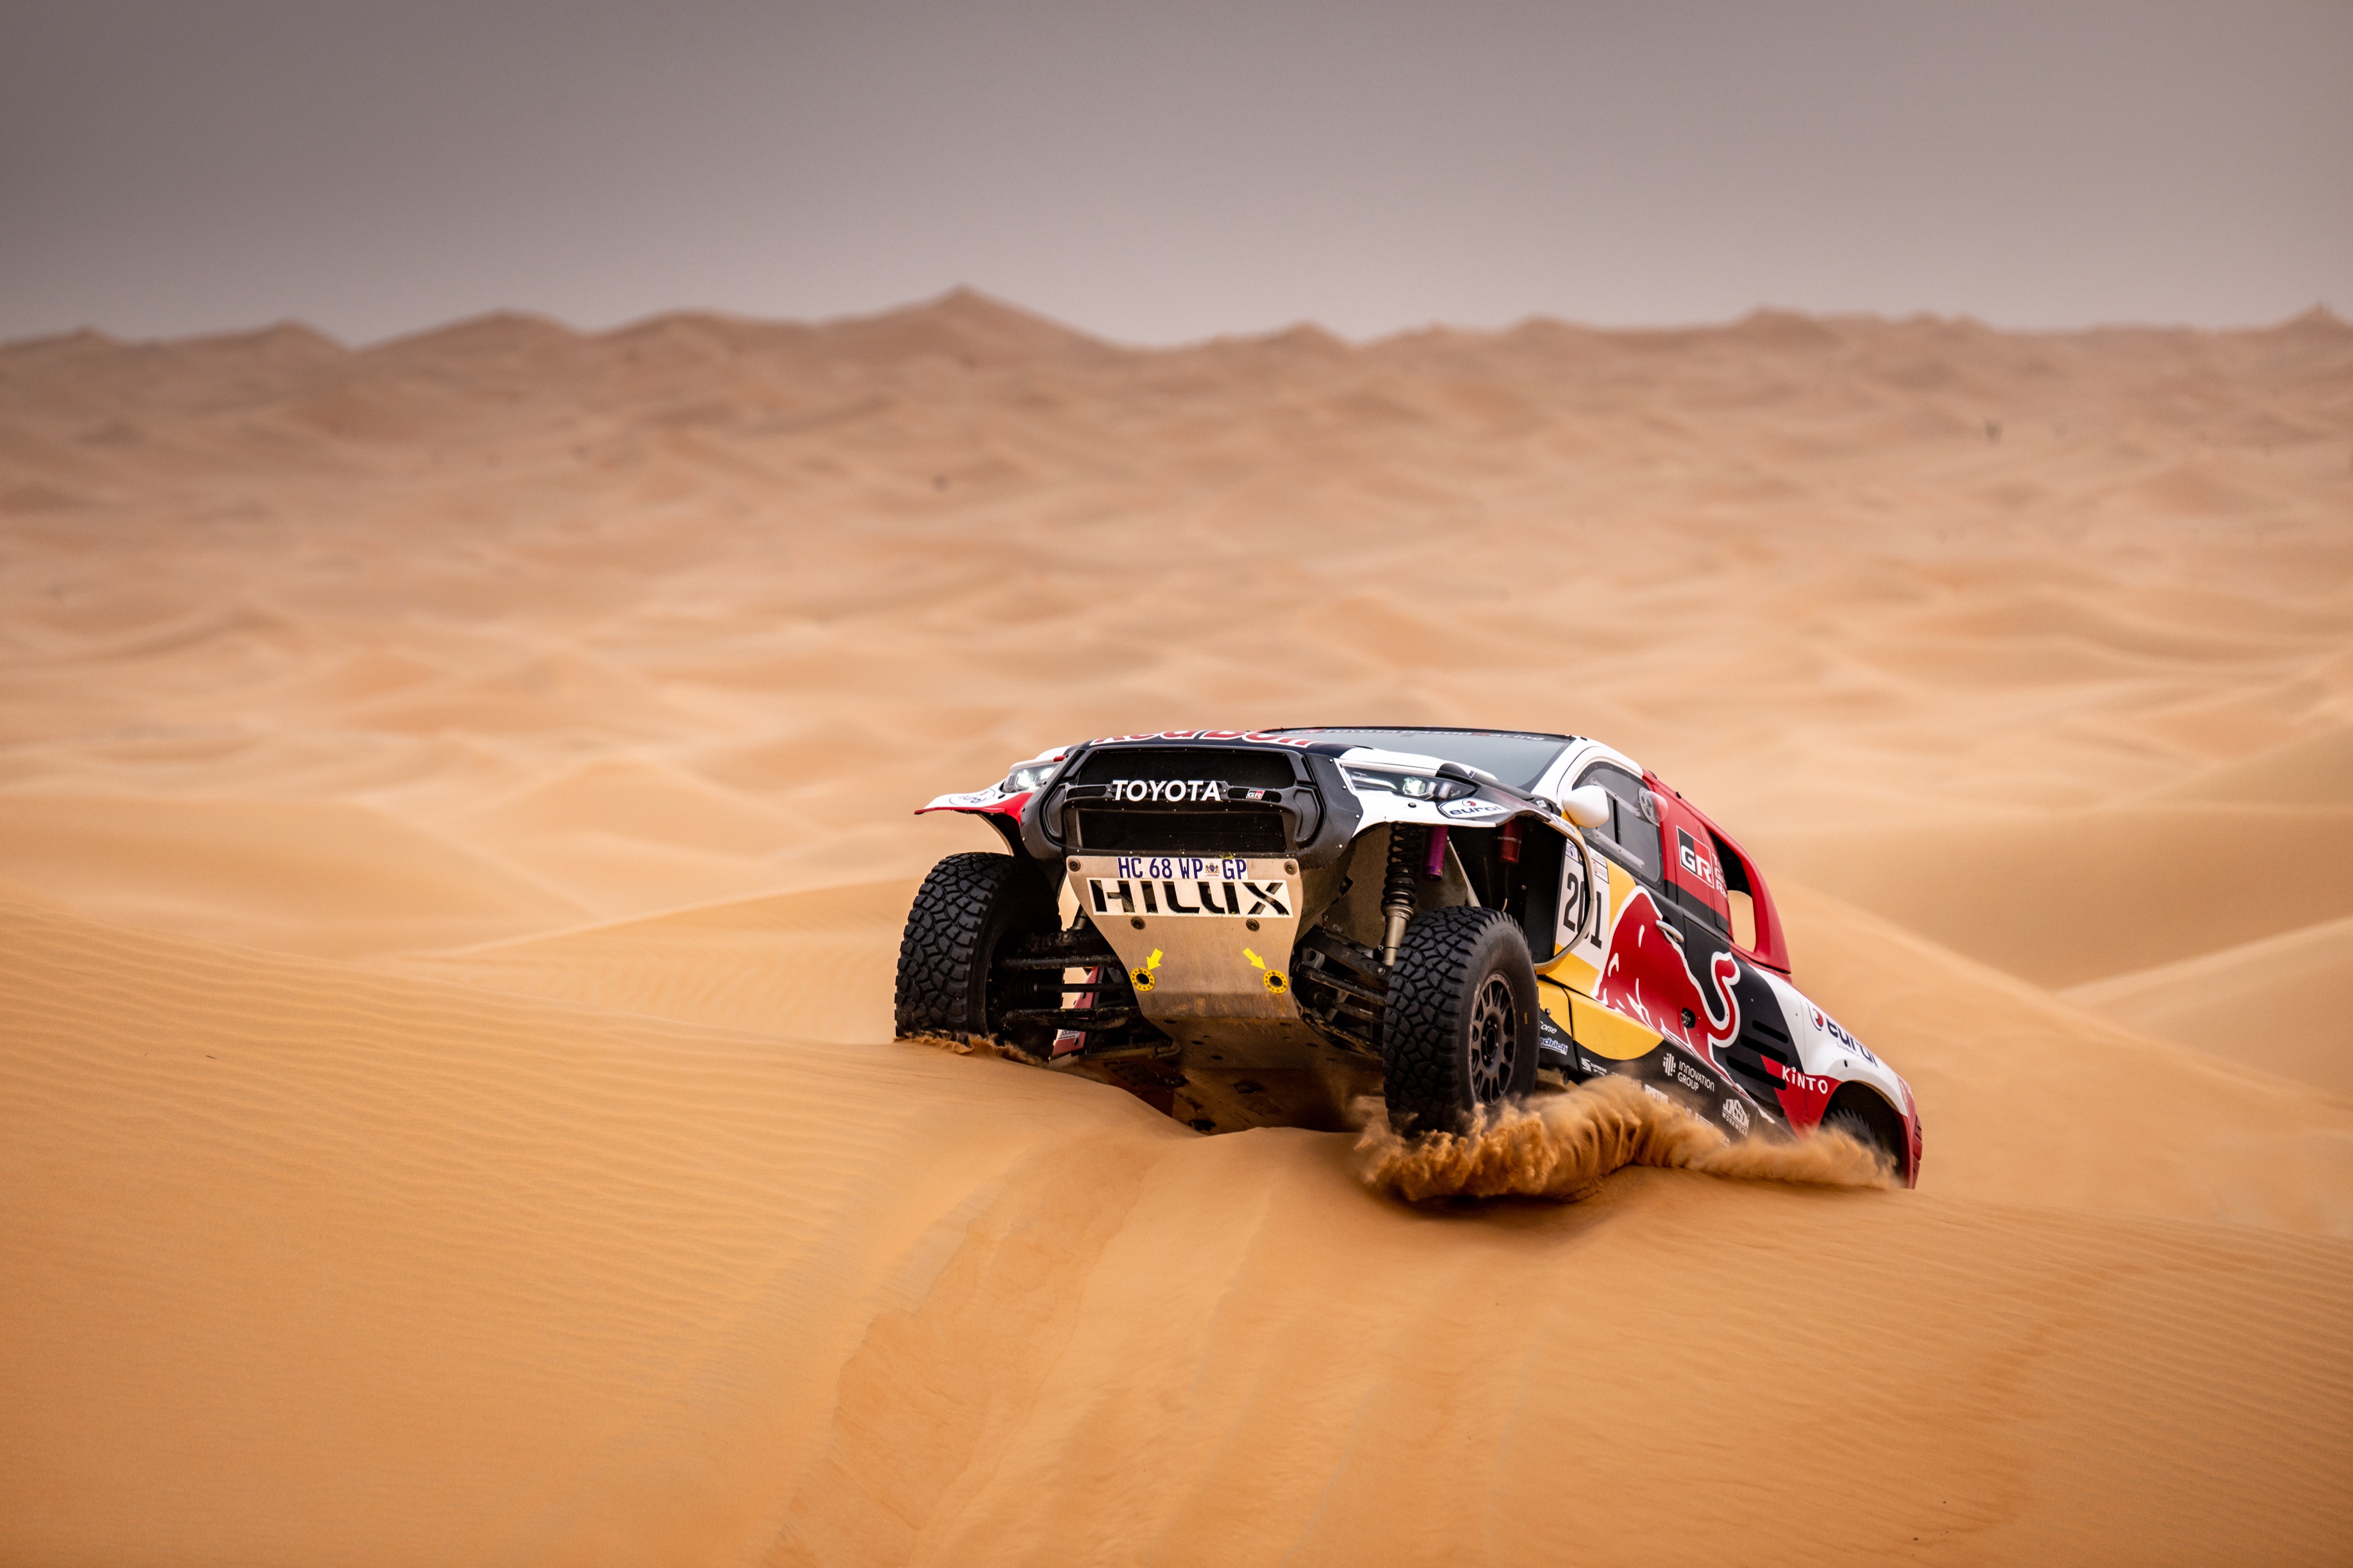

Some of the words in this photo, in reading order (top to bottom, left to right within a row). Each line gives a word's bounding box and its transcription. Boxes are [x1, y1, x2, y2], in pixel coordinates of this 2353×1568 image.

[1112, 780, 1222, 802] TOYOTA
[1449, 806, 1502, 815] eurol
[1117, 857, 1143, 878] HC
[1149, 858, 1172, 879] 68
[1178, 858, 1203, 879] WP
[1222, 859, 1247, 880] GP
[1681, 845, 1712, 884] GR
[1089, 879, 1290, 915] HILUX
[1677, 1072, 1699, 1091] GROUP
[1722, 1099, 1750, 1130] JONSSON
[1722, 1110, 1748, 1138] WORKWEAR
